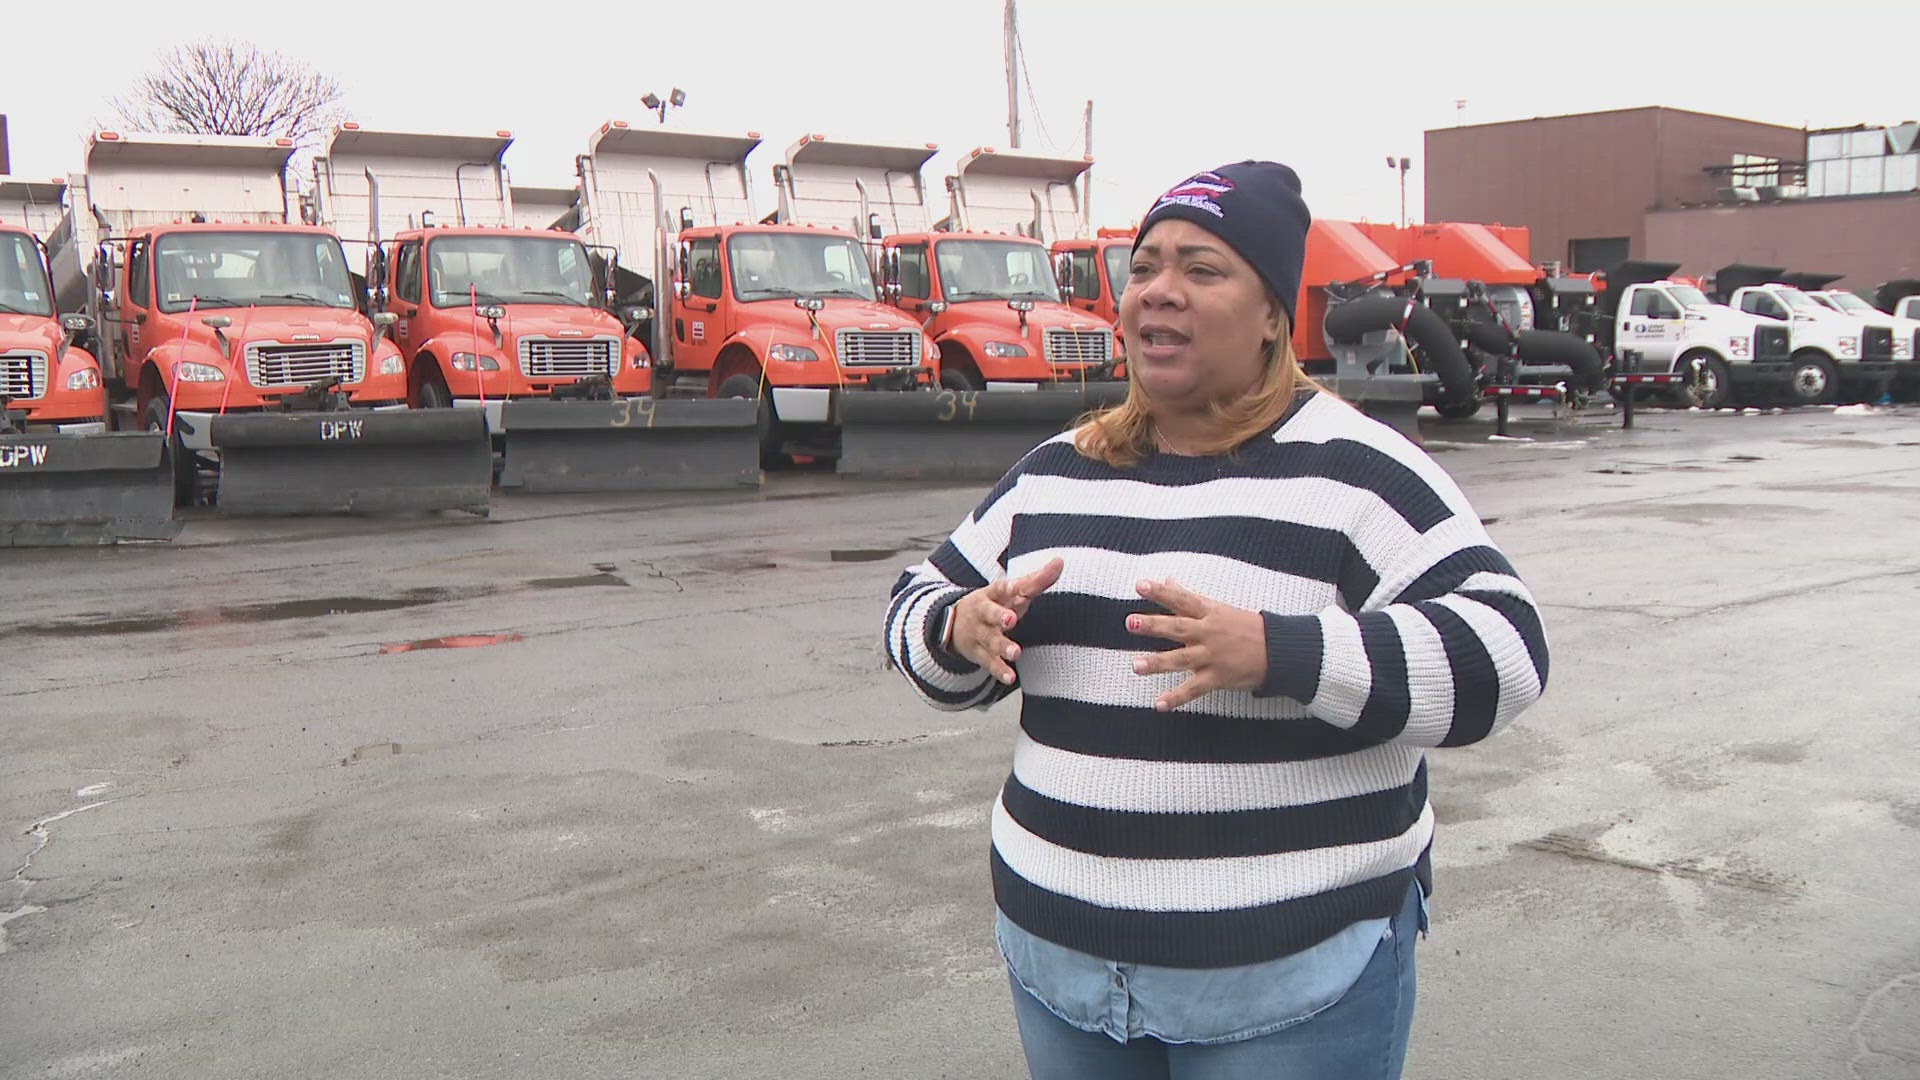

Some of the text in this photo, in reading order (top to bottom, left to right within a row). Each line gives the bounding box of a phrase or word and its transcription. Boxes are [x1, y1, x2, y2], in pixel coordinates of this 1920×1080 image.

[611, 399, 655, 428] 34
[935, 389, 979, 420] 34
[321, 420, 363, 440] DPW
[0, 445, 48, 467] DPW
